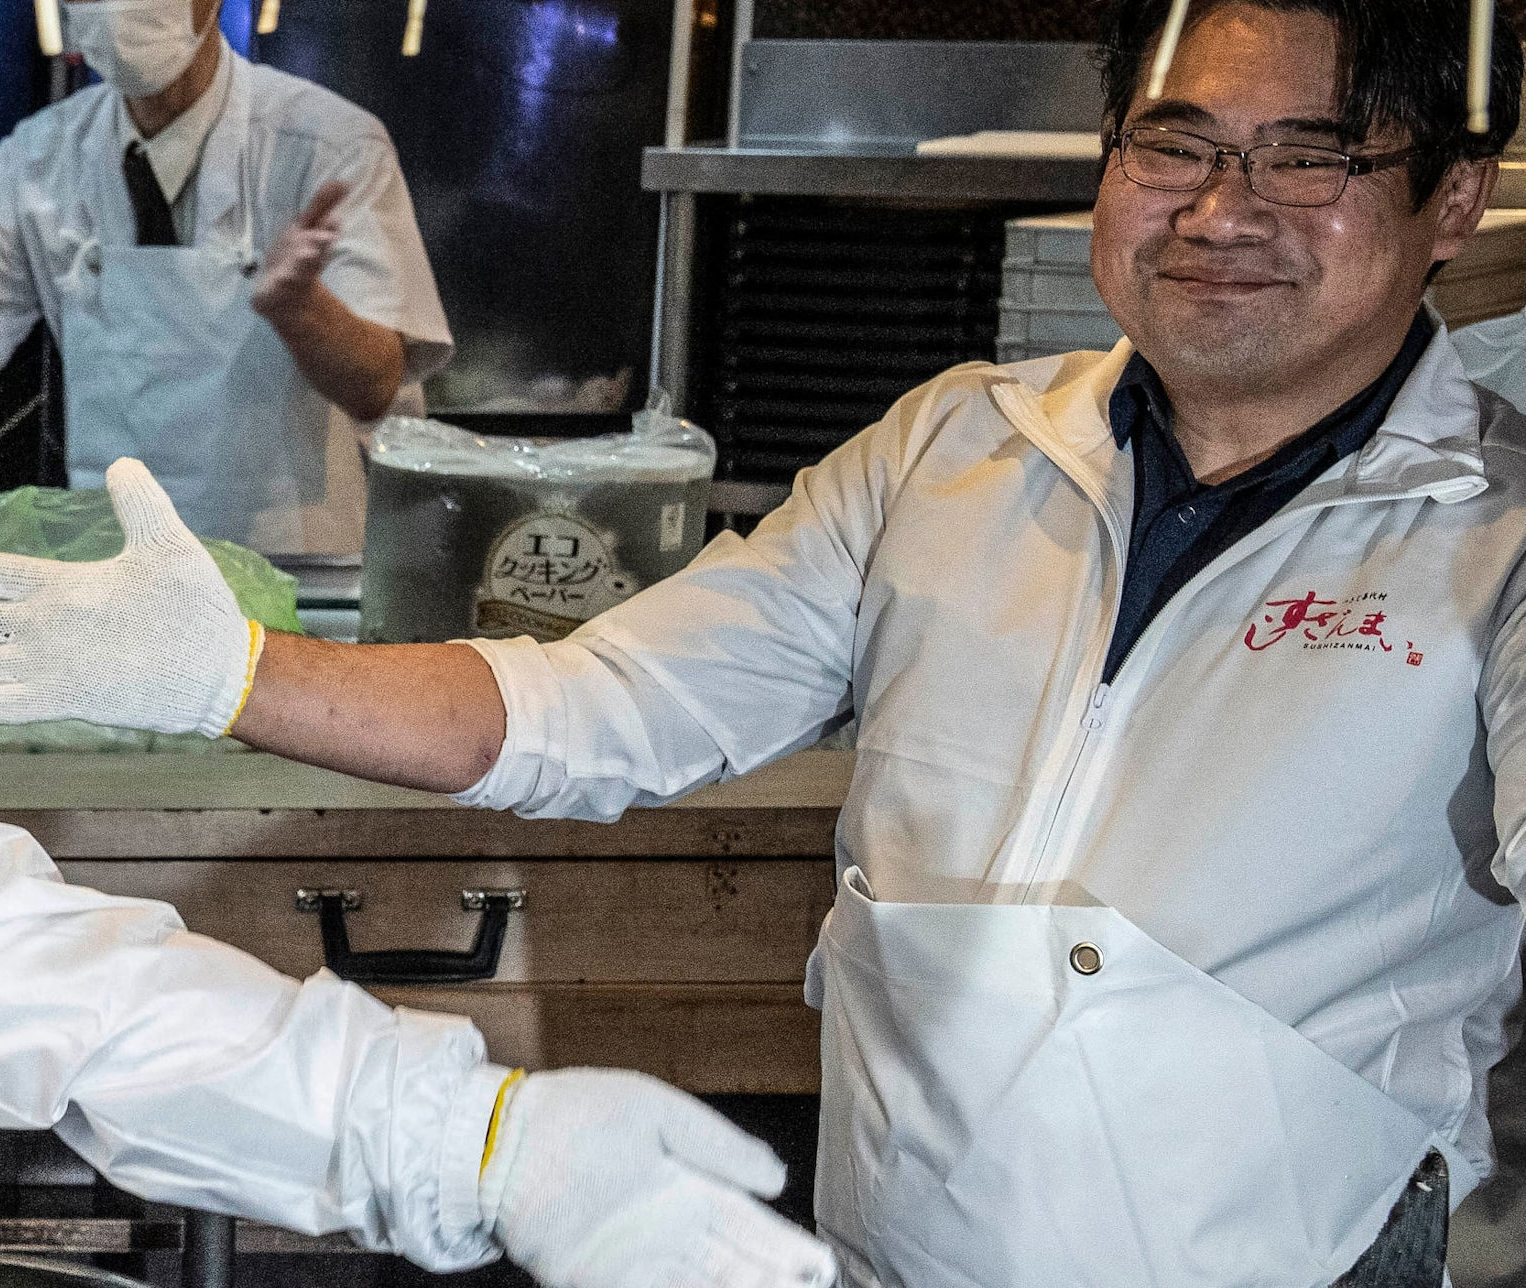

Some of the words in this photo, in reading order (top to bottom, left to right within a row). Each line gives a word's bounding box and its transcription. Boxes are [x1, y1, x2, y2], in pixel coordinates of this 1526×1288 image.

[522, 534, 580, 558] エコ
[496, 556, 607, 586] クッキング
[510, 584, 585, 603] ペーパー
[1303, 643, 1376, 651] SUSHIZANMAI
